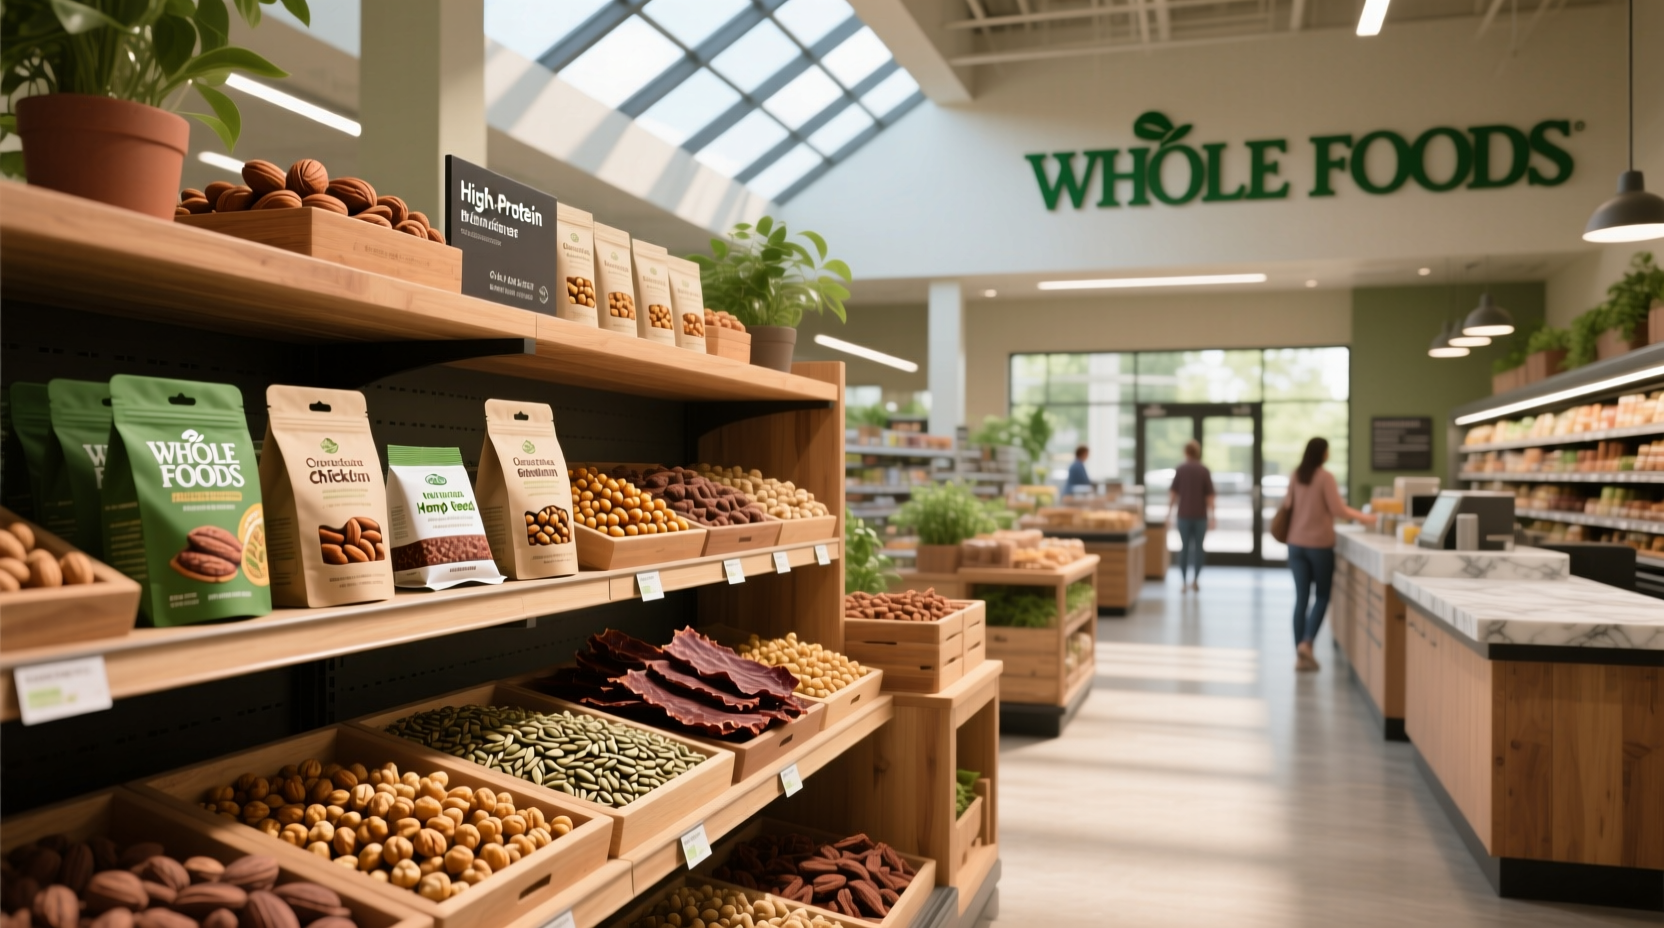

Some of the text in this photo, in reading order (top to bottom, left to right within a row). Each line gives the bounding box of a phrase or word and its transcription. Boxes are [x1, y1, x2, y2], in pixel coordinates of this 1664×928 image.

[1025, 119, 1575, 211] WHOLE FOODS
[146, 441, 240, 465] WHOLE
[159, 464, 245, 488] FOODS
